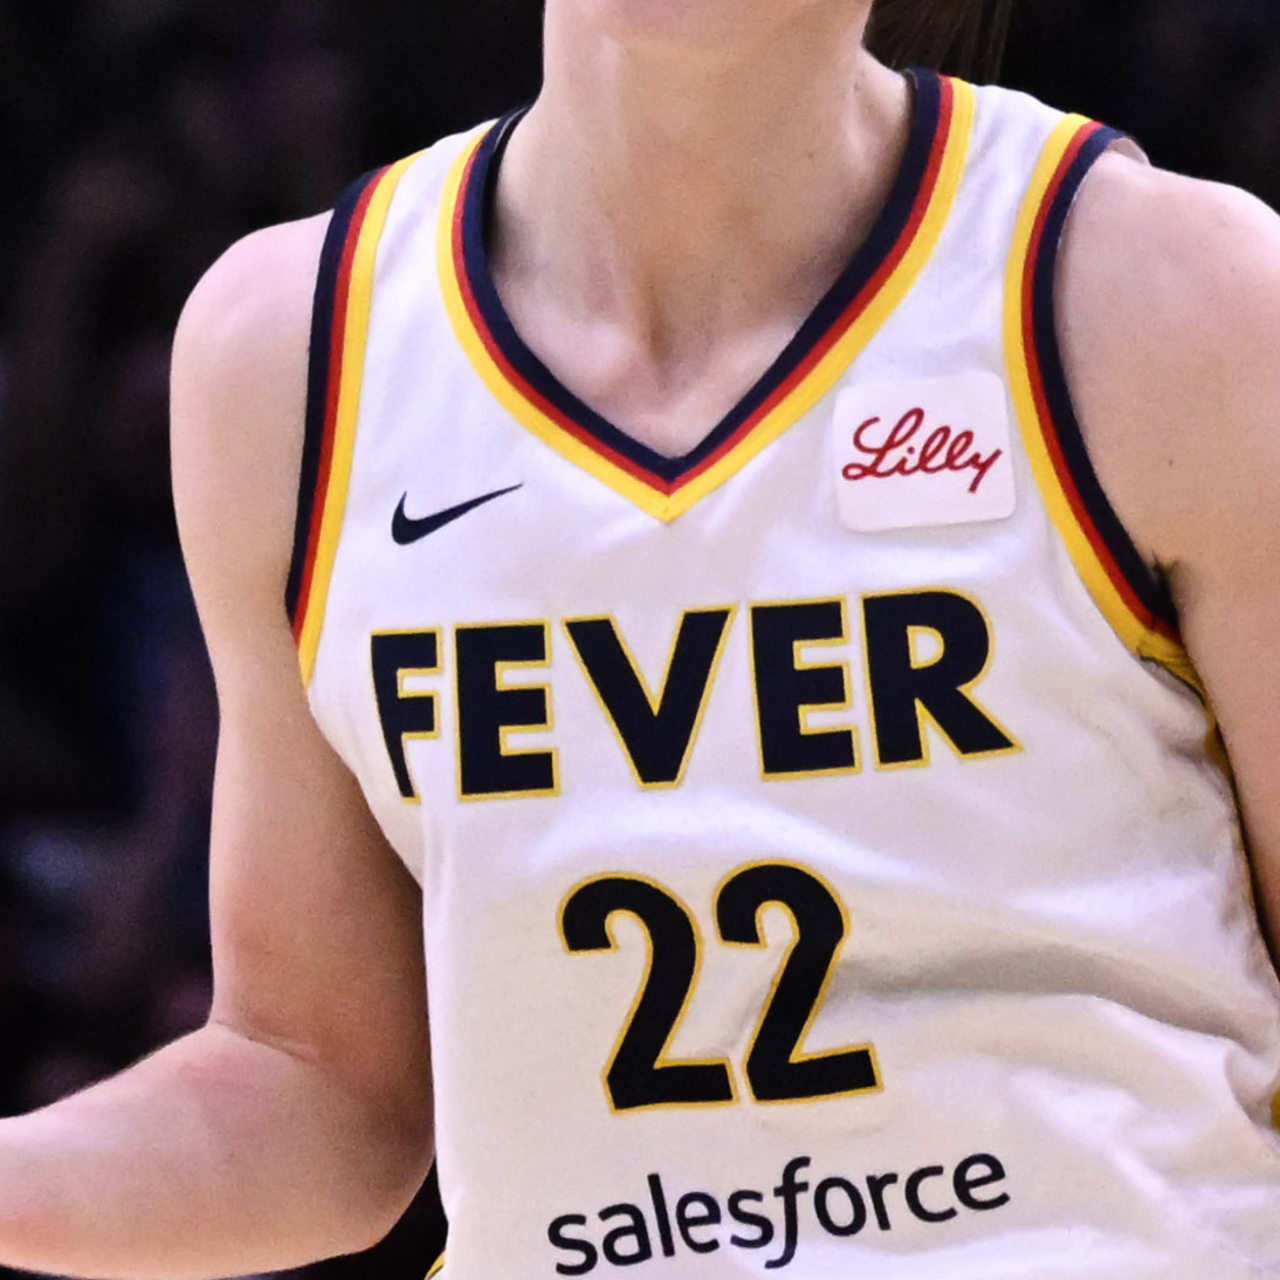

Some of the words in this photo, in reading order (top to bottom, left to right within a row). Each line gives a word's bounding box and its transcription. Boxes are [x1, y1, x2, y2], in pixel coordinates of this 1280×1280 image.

[841, 406, 1003, 494] Lilly
[369, 585, 1025, 805] FEVER
[556, 858, 884, 1116] 22
[547, 1152, 1011, 1276] salesforce
